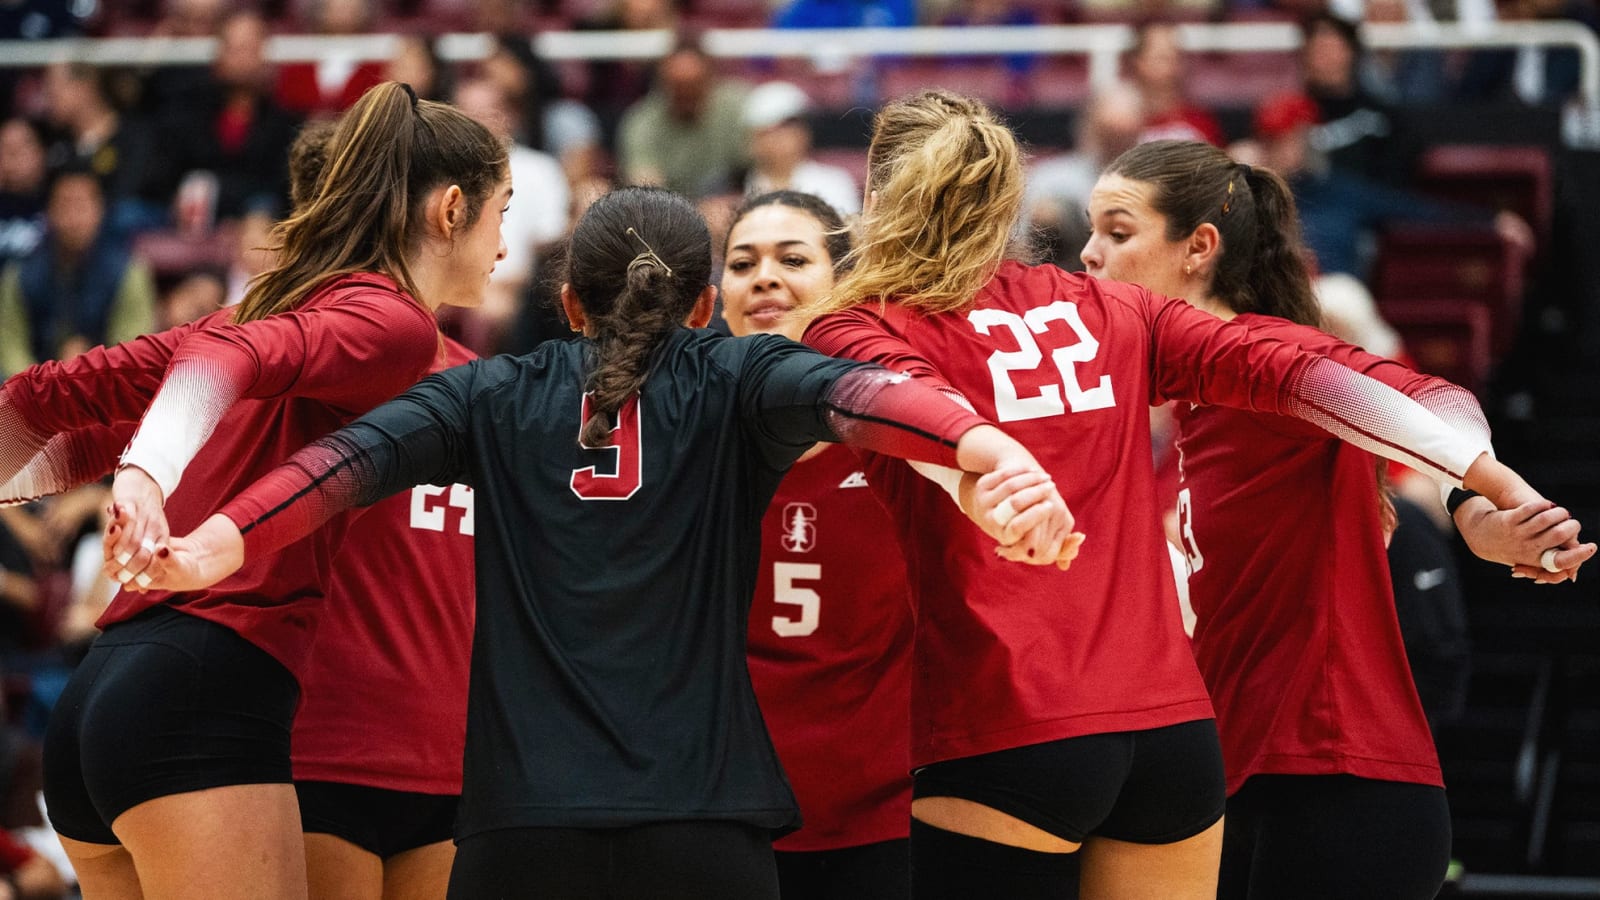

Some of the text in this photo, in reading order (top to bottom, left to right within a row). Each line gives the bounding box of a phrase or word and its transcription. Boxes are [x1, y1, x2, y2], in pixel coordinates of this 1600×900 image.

[967, 300, 1117, 423] 22
[570, 390, 643, 501] 9
[771, 561, 822, 638] 5
